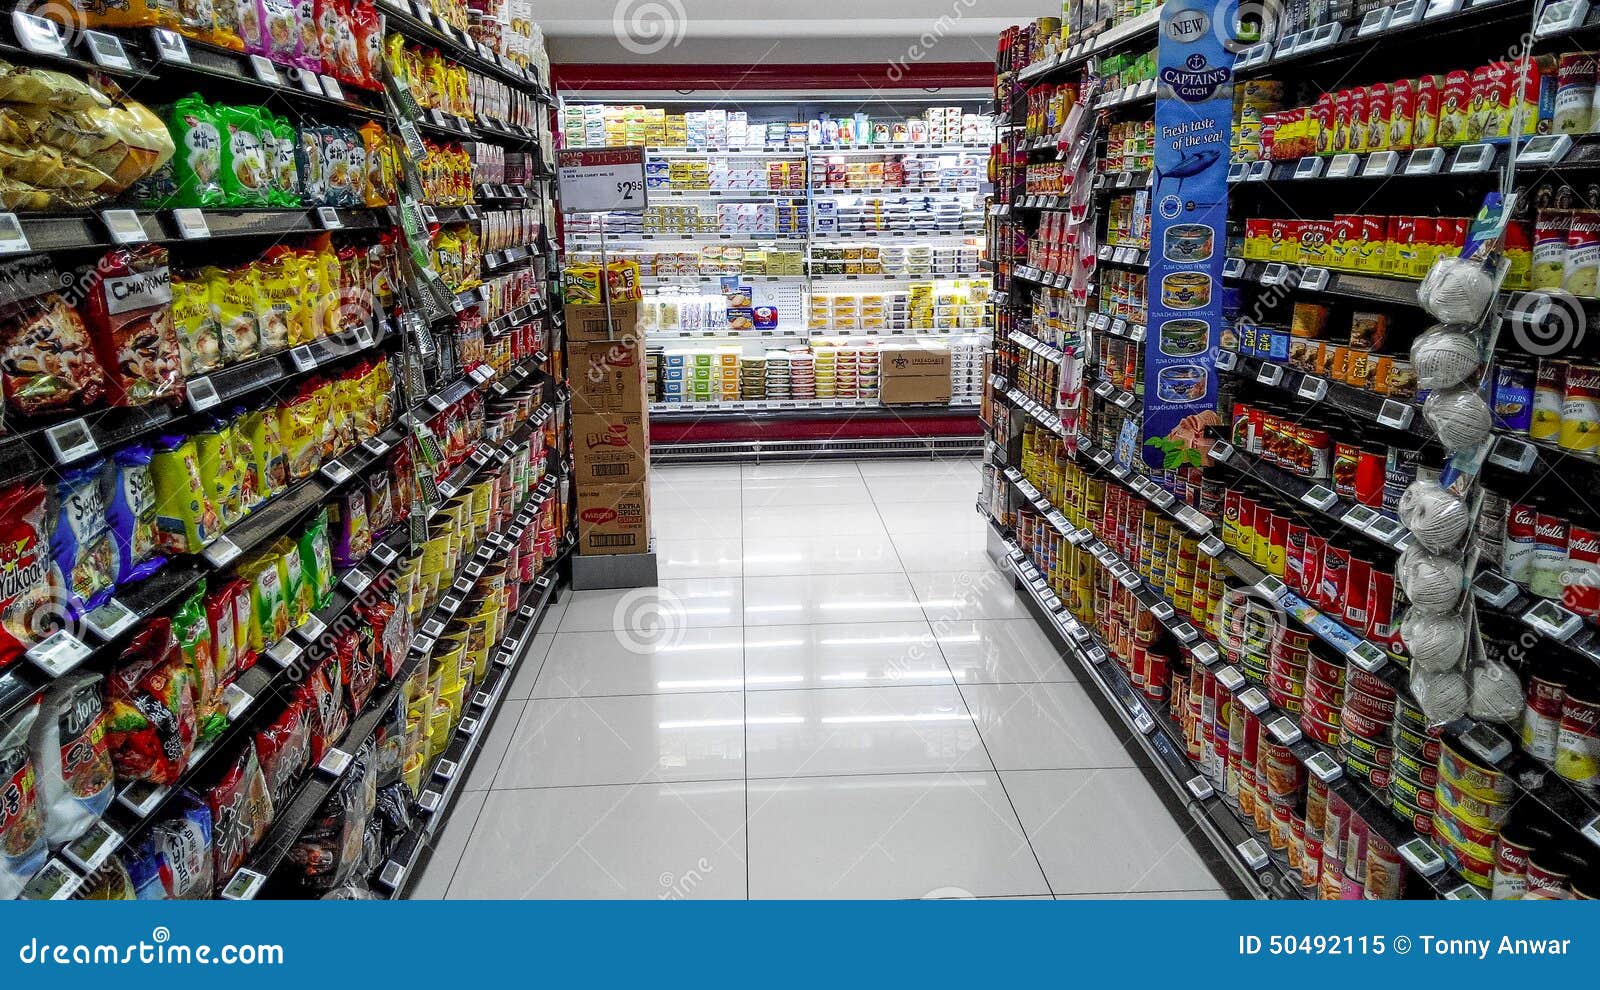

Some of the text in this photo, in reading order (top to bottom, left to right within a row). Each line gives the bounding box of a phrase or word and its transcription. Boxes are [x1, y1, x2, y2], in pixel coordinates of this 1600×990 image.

[1172, 18, 1203, 36] NEW
[1165, 69, 1226, 83] CAPTAIN'S
[1181, 87, 1208, 96] CATCH
[1162, 118, 1216, 139] Fresh taste
[1172, 131, 1224, 150] of the sea!
[566, 275, 584, 286] BIG
[623, 267, 635, 290] BIG
